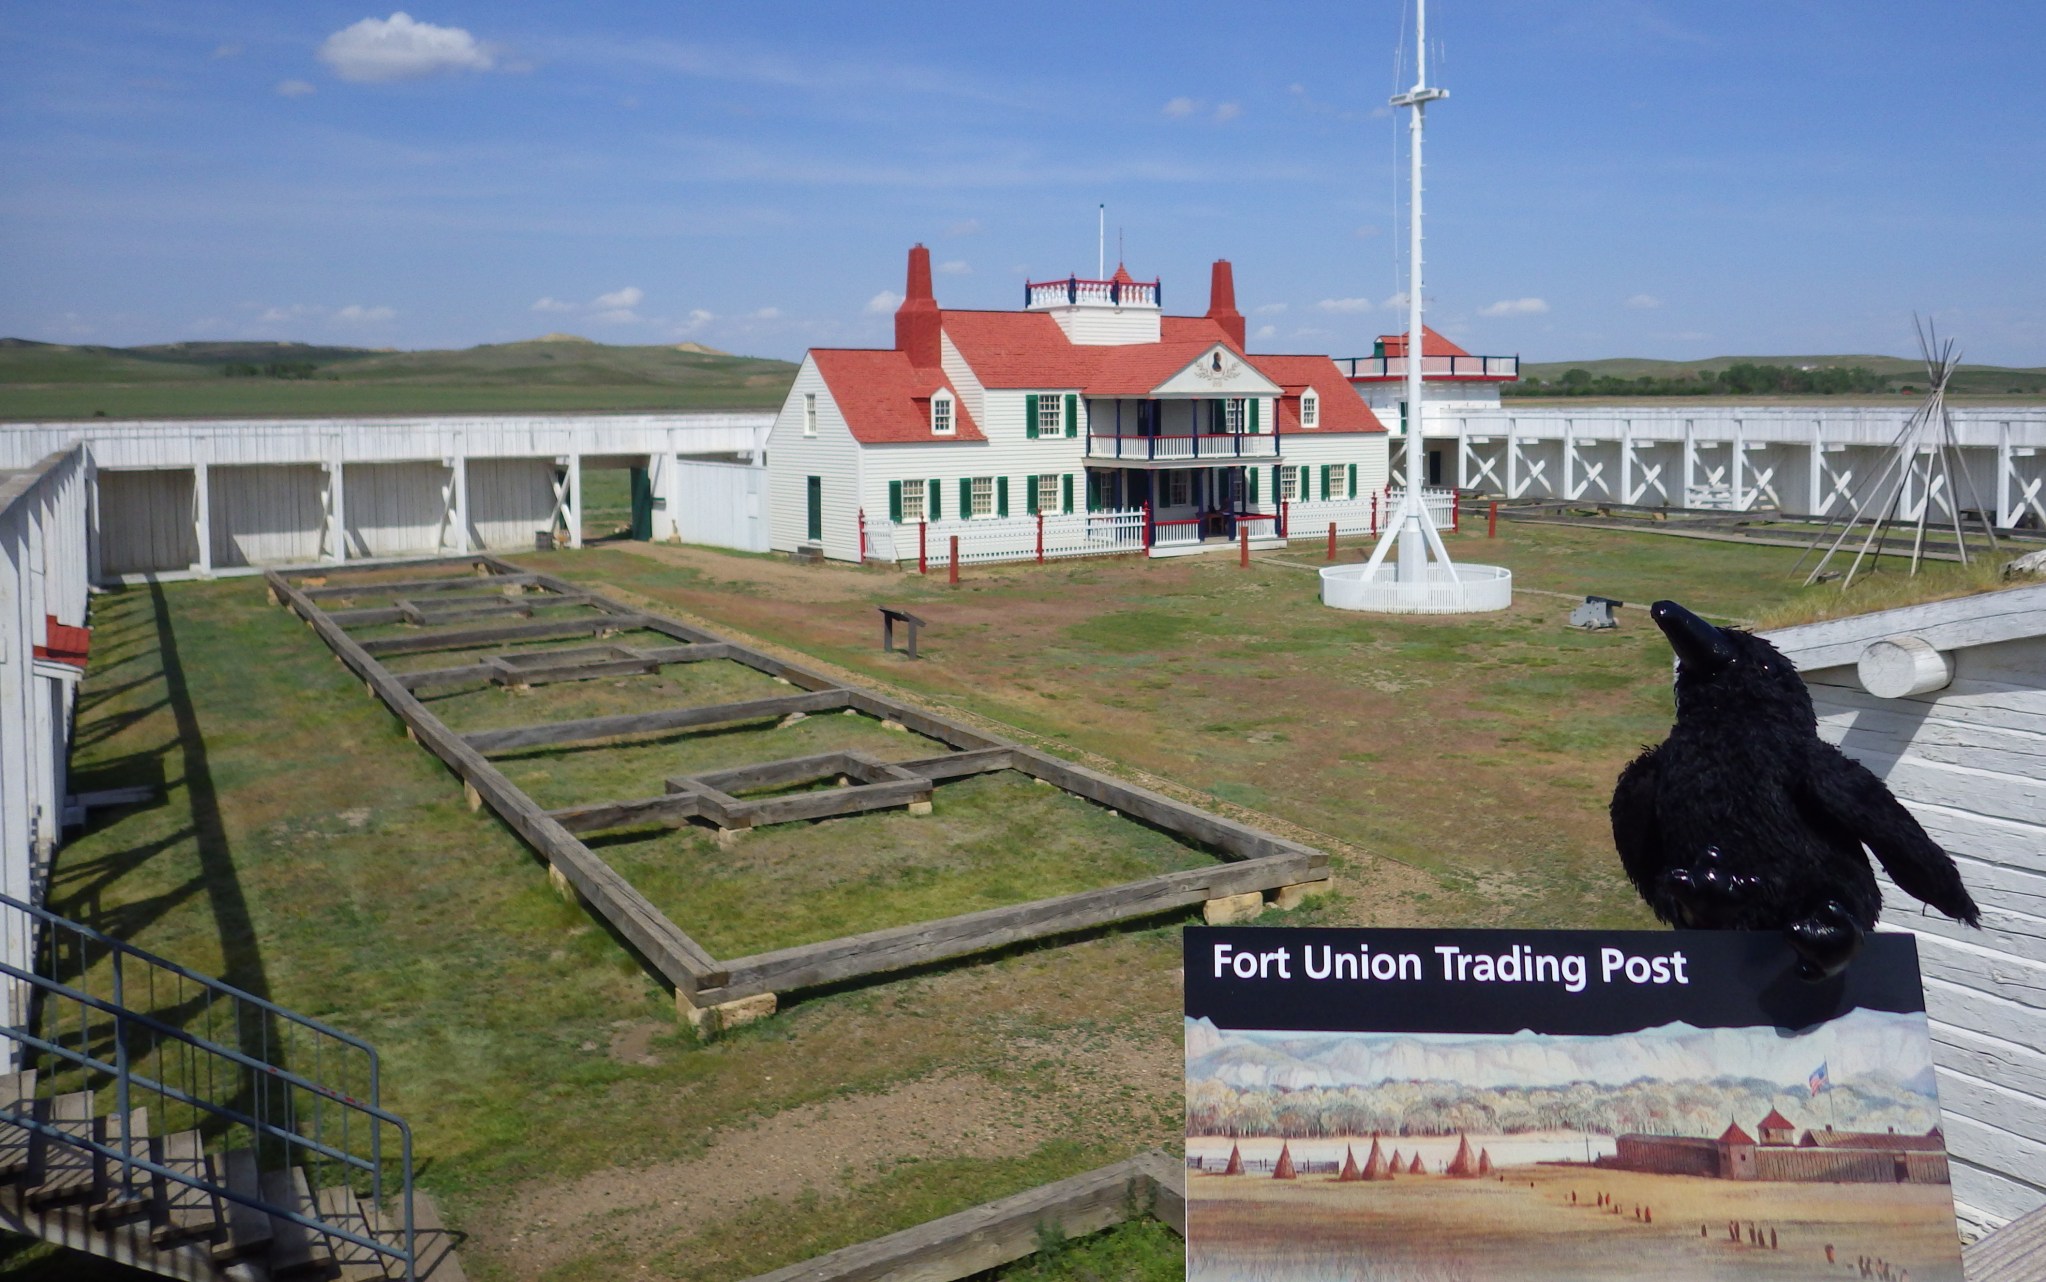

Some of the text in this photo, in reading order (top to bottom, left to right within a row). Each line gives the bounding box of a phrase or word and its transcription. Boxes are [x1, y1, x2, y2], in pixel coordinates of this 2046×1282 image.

[1213, 943, 1689, 993] Fort Union Trading Post
